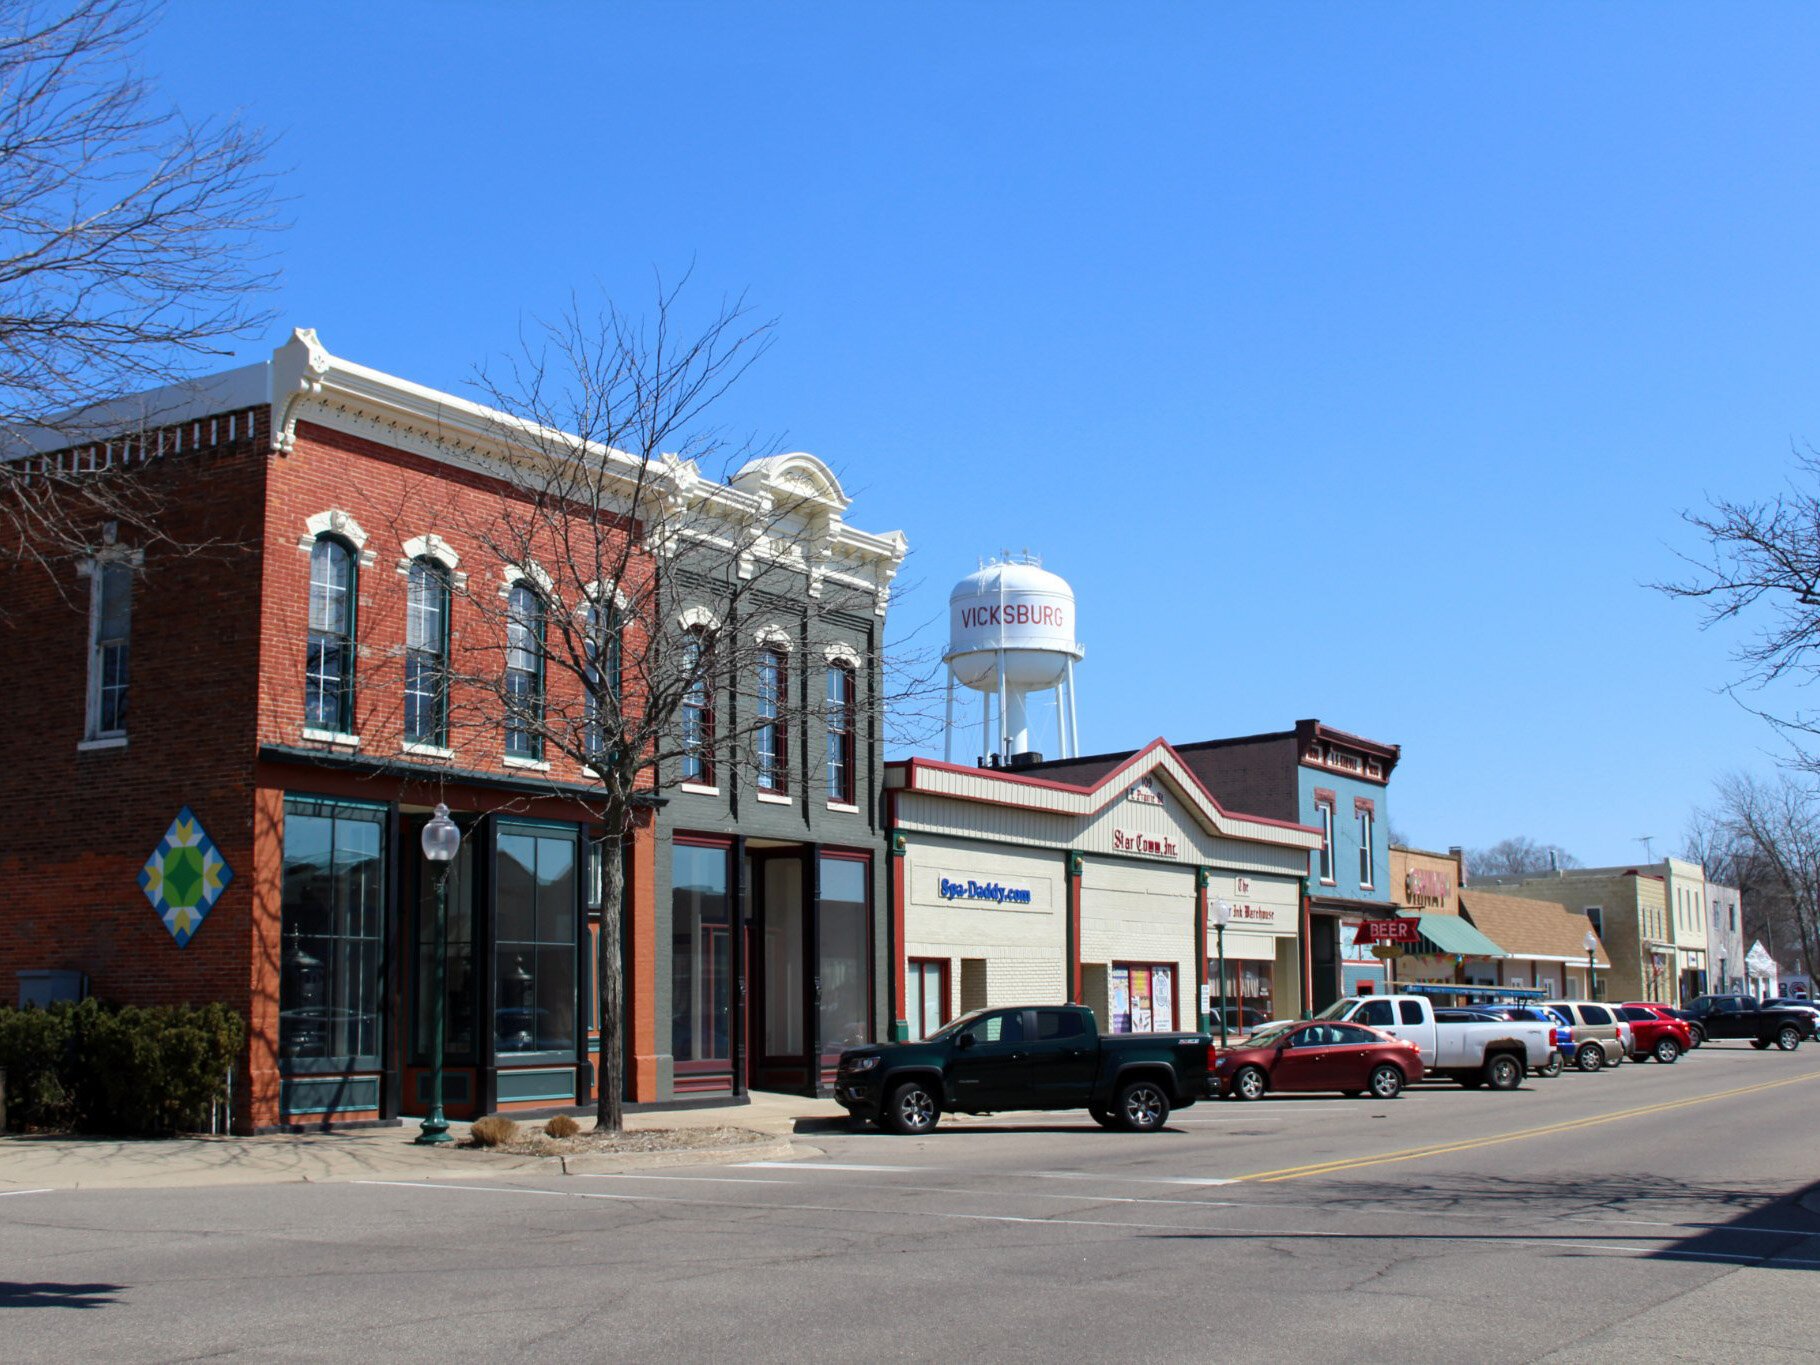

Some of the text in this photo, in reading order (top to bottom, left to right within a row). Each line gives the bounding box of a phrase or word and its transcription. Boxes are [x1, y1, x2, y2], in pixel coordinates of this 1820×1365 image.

[961, 604, 1063, 628] VICKSBURG
[1141, 776, 1153, 788] 109
[1114, 828, 1134, 850] Star
[1163, 836, 1178, 856] Inc.
[941, 878, 1031, 904] Spa-Daddy.com
[1237, 878, 1249, 893] The
[1233, 904, 1243, 918] Ink
[1244, 904, 1275, 920] Warehouse
[1370, 923, 1407, 937] BEER
